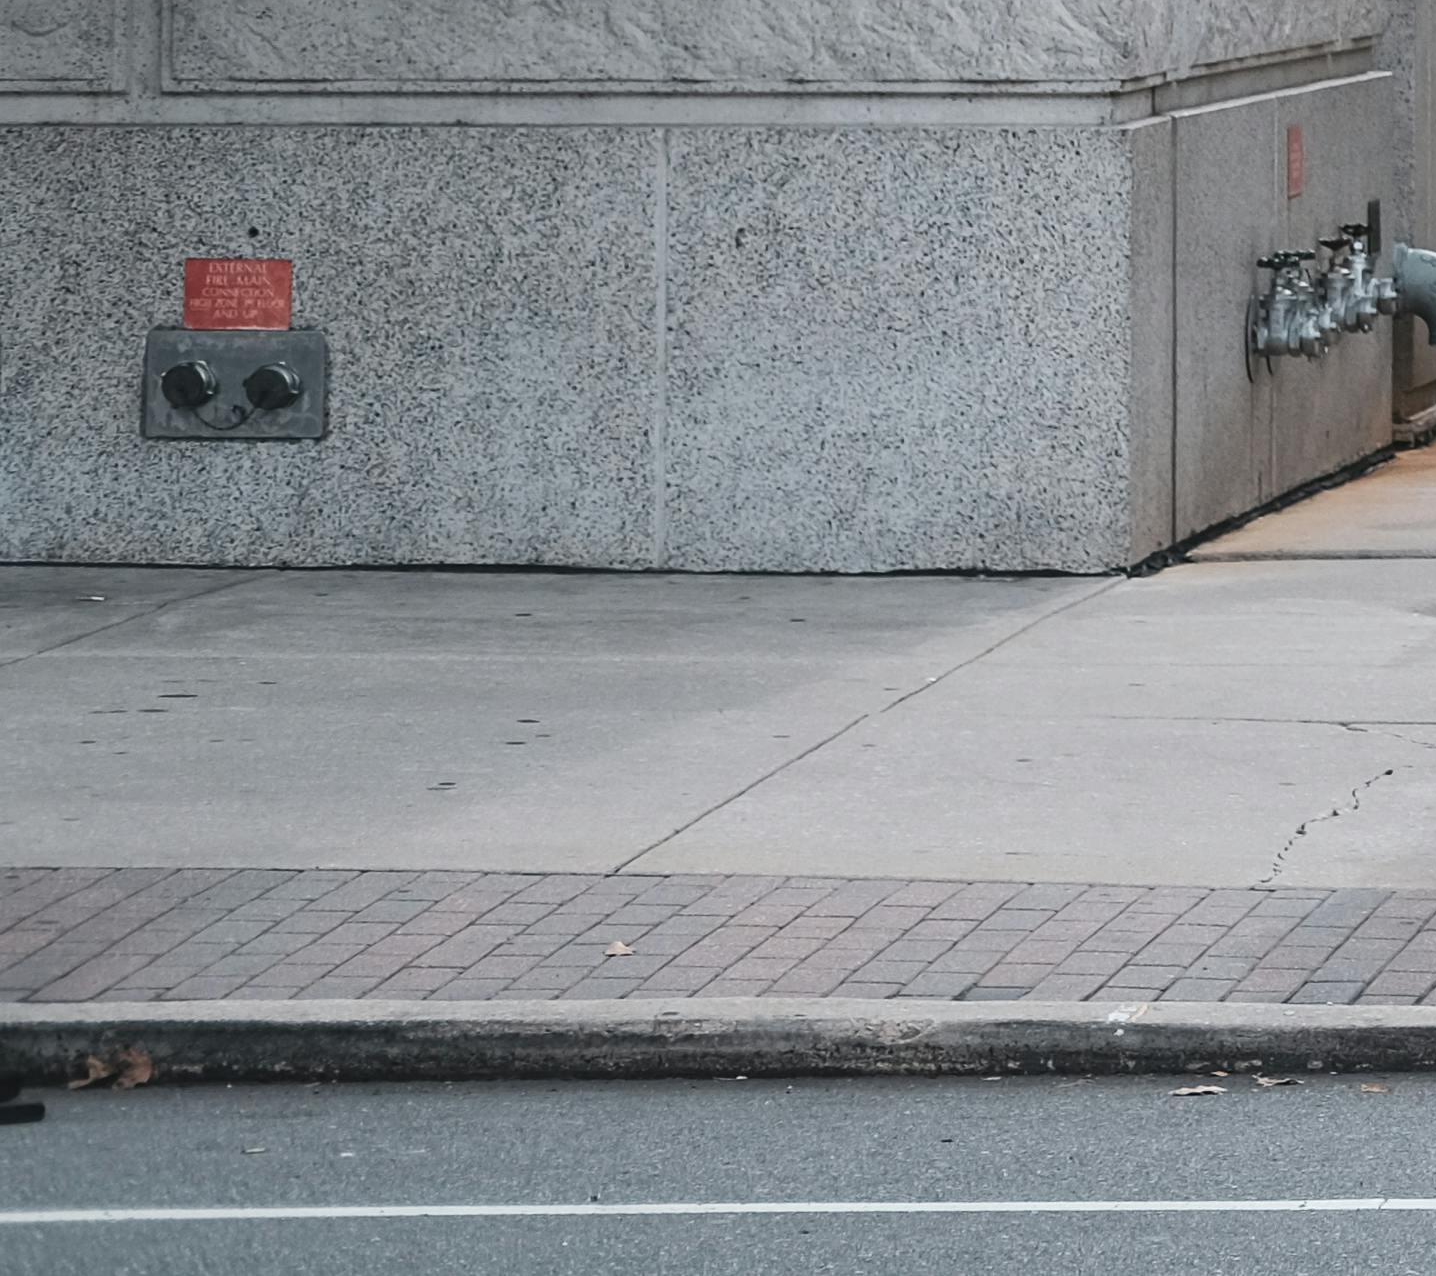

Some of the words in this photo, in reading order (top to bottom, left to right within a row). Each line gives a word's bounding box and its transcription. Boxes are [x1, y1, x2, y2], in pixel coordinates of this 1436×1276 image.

[209, 262, 267, 274] EXTERNAL
[206, 274, 228, 285] FIRE
[201, 287, 274, 297] CONNECTION
[213, 309, 238, 319] AND
